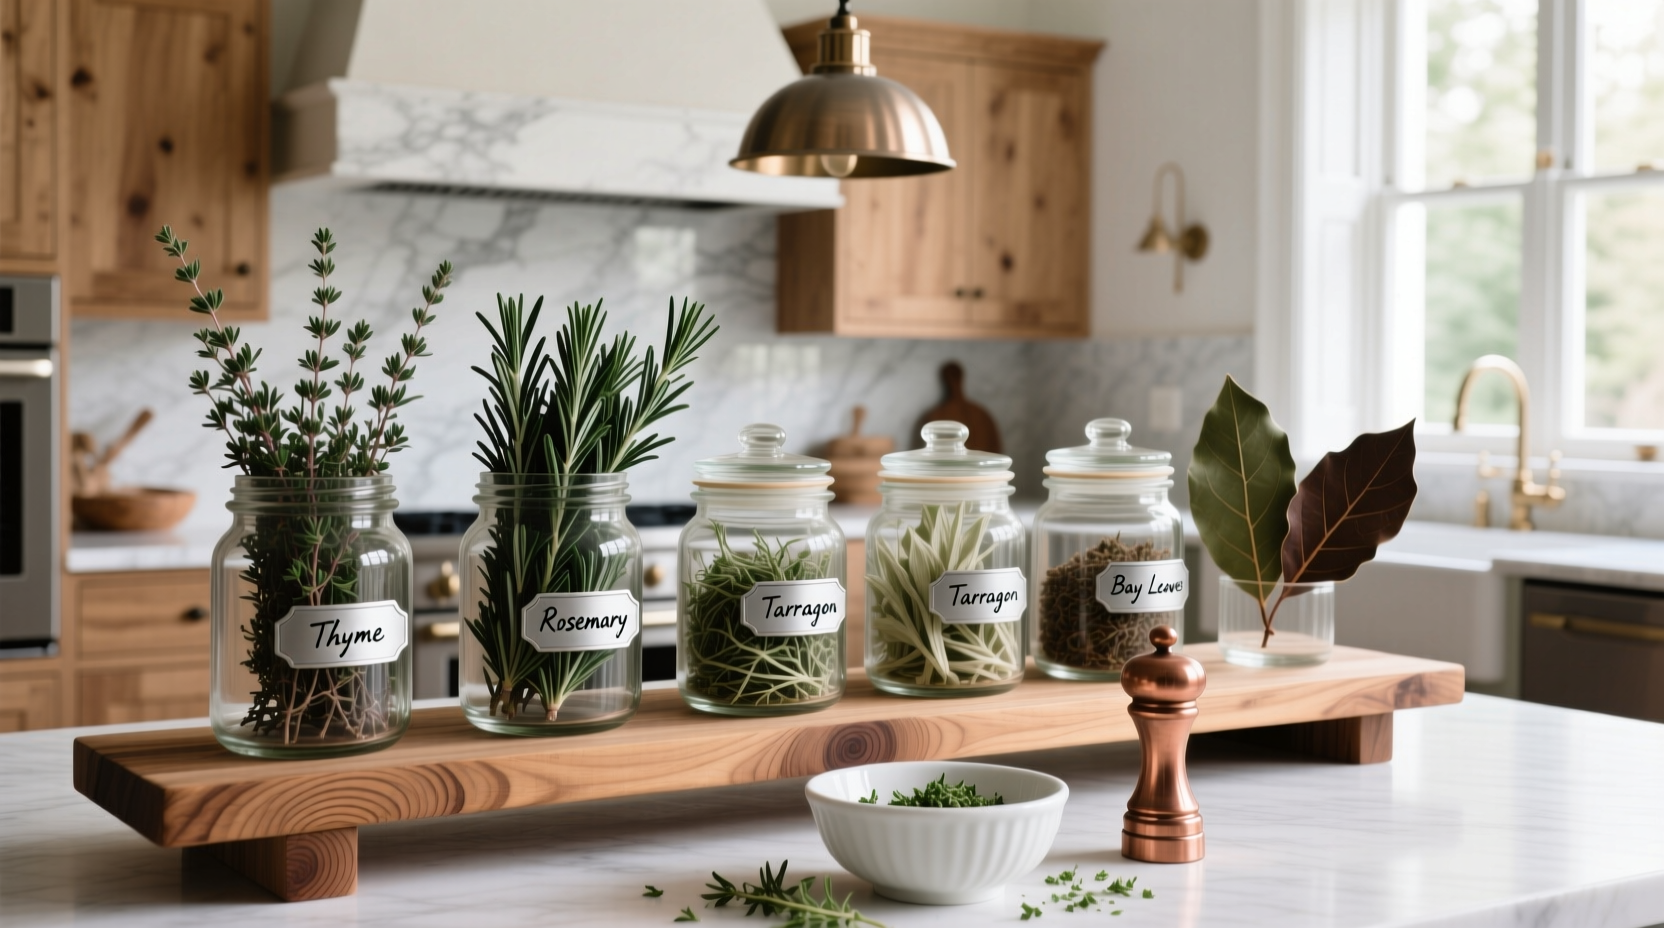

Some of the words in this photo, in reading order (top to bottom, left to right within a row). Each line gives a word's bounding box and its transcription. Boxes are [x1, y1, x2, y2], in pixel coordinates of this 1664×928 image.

[949, 584, 1018, 613] Tarragon
[1110, 574, 1143, 604] Bay
[539, 606, 628, 638] Rosemary
[762, 595, 837, 627] Tarragon
[310, 619, 385, 657] Thyme
